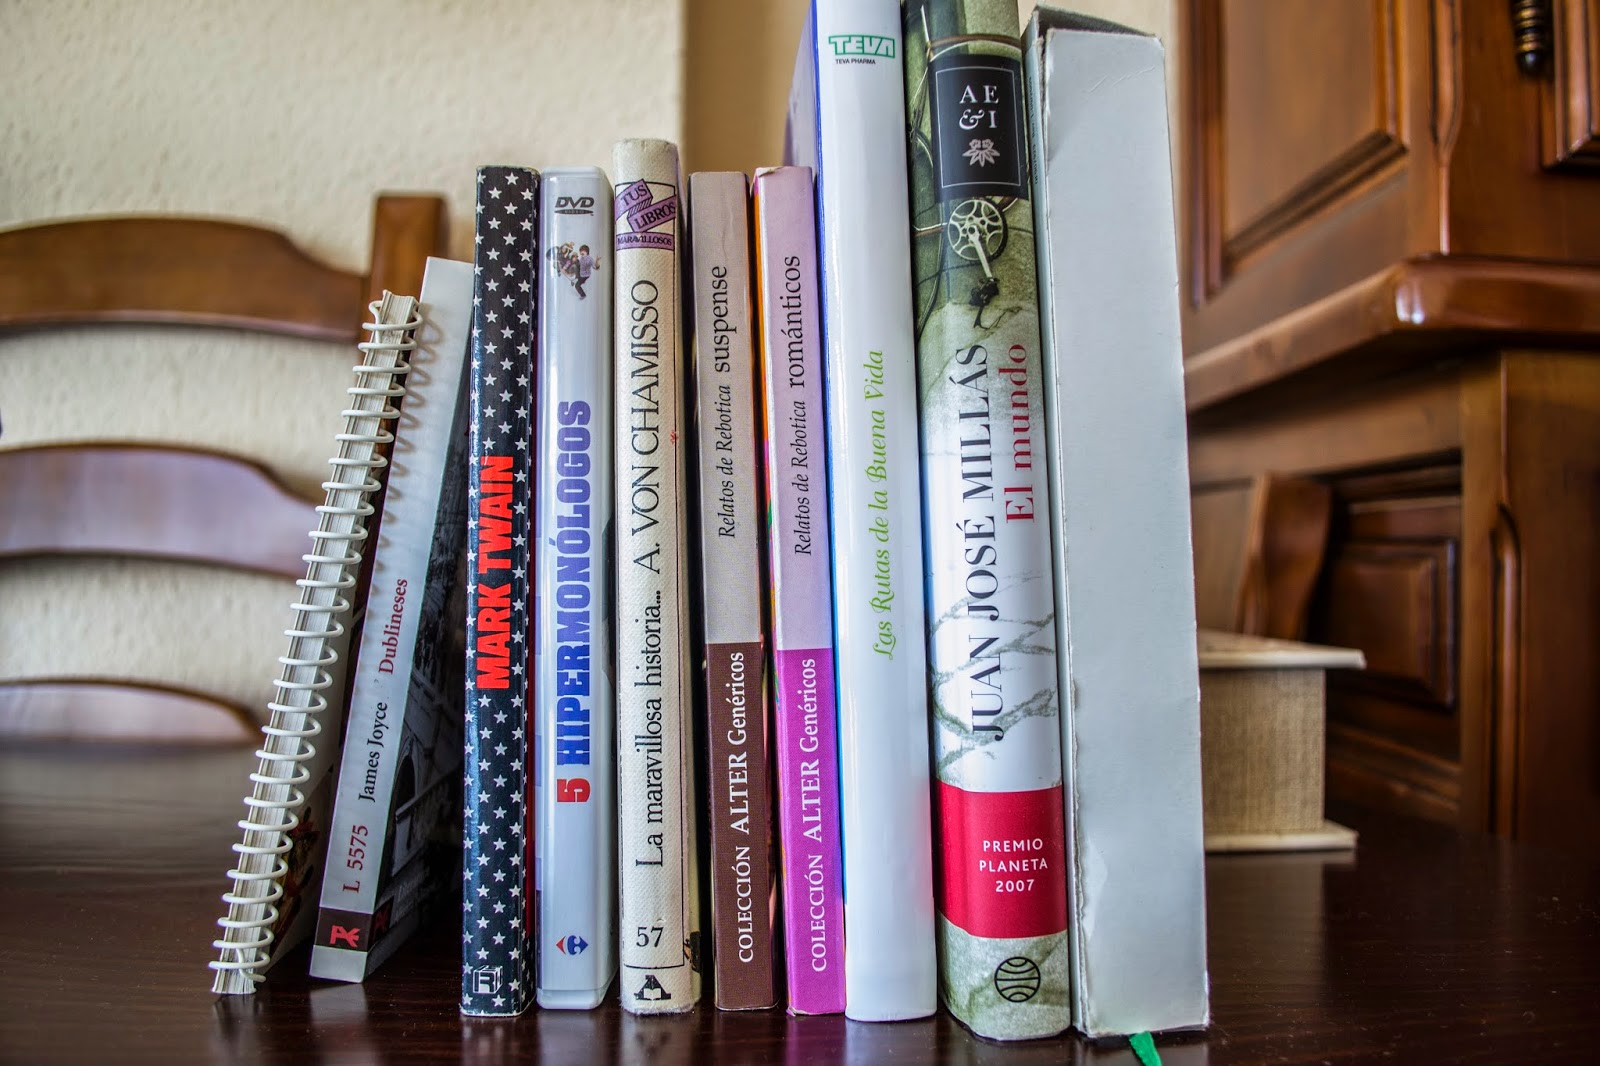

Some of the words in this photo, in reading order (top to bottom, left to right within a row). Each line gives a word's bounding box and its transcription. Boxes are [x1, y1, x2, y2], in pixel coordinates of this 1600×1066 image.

[828, 34, 896, 59] TEVA
[958, 109, 985, 130] &
[989, 110, 998, 129] I
[959, 85, 978, 104] A
[983, 85, 999, 104] E
[555, 197, 594, 208] DVD
[620, 184, 648, 206] TUS
[634, 202, 676, 229] LIBROS
[617, 235, 672, 246] MARAVILLOSOS
[711, 265, 737, 373] suspense
[781, 255, 806, 389] románticos
[631, 280, 660, 456] CHAMISSO
[862, 350, 884, 403] Vida
[715, 384, 733, 453] Rebotica
[791, 400, 808, 469] Rebotica
[948, 344, 994, 502] MILLÁS
[998, 343, 1032, 472] mundo
[717, 456, 734, 476] de
[866, 409, 888, 484] Buena
[631, 464, 660, 537] VON
[719, 481, 736, 539] Relatos
[792, 474, 809, 492] de
[867, 490, 888, 511] la
[1003, 485, 1035, 524] El
[478, 455, 514, 574] TWAIN
[794, 498, 812, 557] Relatos
[869, 516, 890, 543] de
[549, 400, 591, 766] HIPERMONÓLOGOS
[633, 542, 660, 575] A.
[868, 549, 895, 614] Rutas
[955, 515, 1000, 622] JOSÉ
[378, 578, 408, 675] Dublineses
[476, 583, 512, 689] MARK
[634, 590, 662, 687] historia...
[872, 618, 894, 662] Las
[726, 651, 747, 747] Genéricos
[798, 657, 820, 754] Genéricos
[970, 634, 1004, 742] JUAN
[367, 702, 389, 748] Joyce
[358, 751, 380, 803] James
[635, 696, 663, 826] maravillosa
[556, 778, 591, 803] 5
[729, 750, 751, 836] ALTER
[801, 758, 823, 844] ALTER
[347, 824, 368, 871] 5575
[635, 833, 663, 868] La
[979, 857, 1048, 873] PLANETA
[983, 838, 1043, 853] PREMIO
[343, 880, 361, 894] L
[735, 845, 754, 964] COLECCIÓN
[809, 853, 827, 973] COLECCIÓN
[995, 878, 1035, 893] 2007
[636, 926, 664, 948] 57
